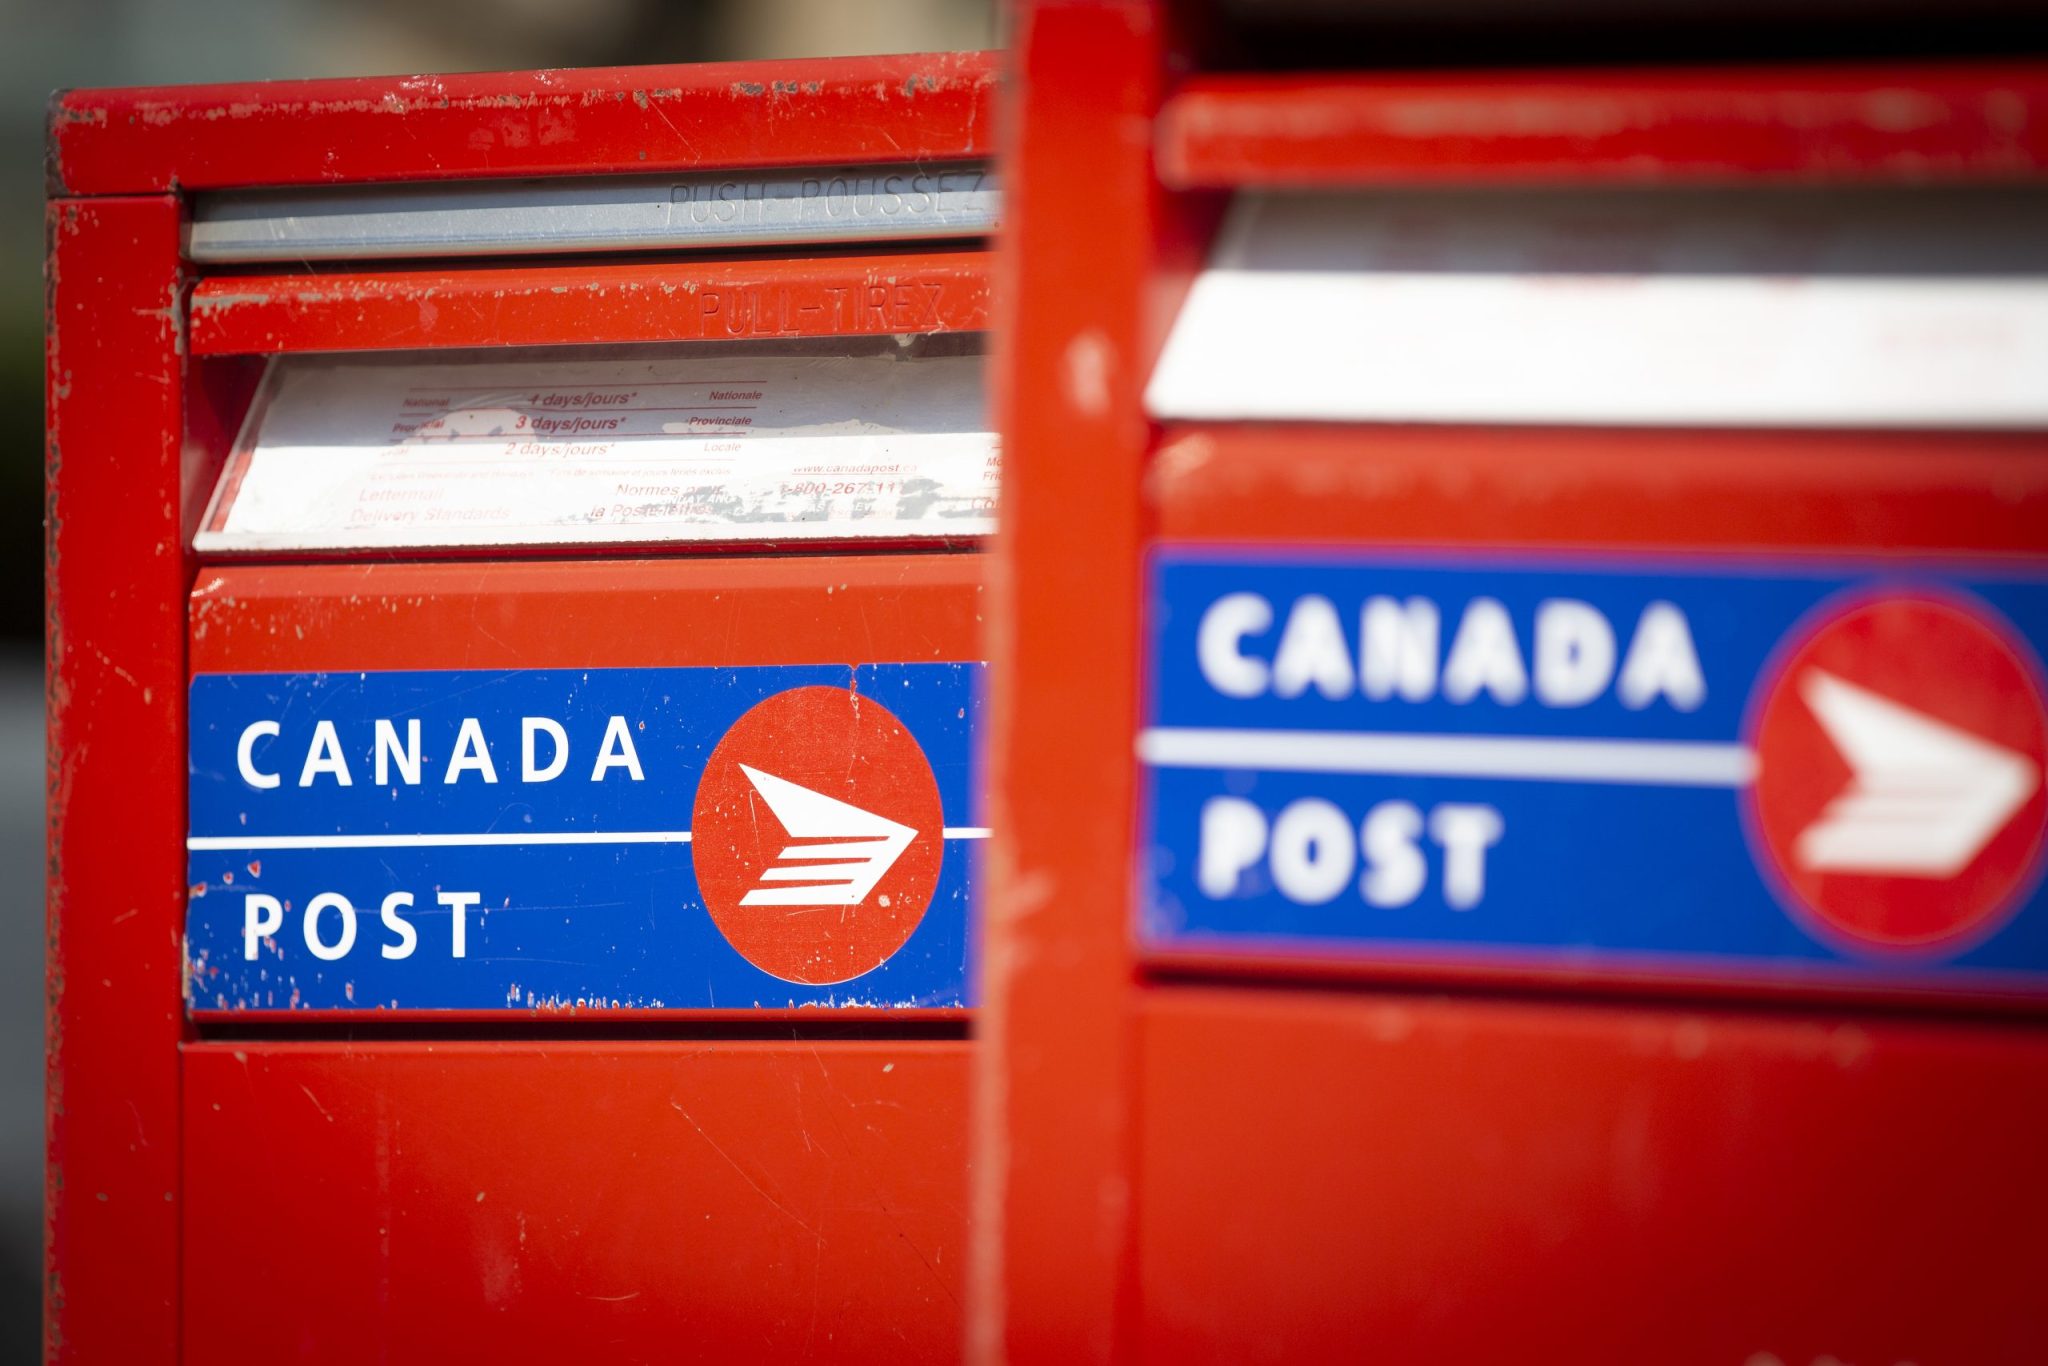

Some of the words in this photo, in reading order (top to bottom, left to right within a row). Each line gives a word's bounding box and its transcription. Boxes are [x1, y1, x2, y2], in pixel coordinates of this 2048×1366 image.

[700, 283, 945, 337] PULL-TIREZ
[709, 390, 762, 401] Nationale
[515, 416, 528, 430] 3
[688, 416, 752, 427] Provinciale
[504, 443, 517, 456] 2
[704, 442, 742, 453] Locale
[616, 483, 681, 497] Normes
[1196, 591, 1708, 713] CANADA
[236, 716, 645, 789] CANADA
[1196, 796, 1506, 912] POST
[244, 891, 481, 961] POST
